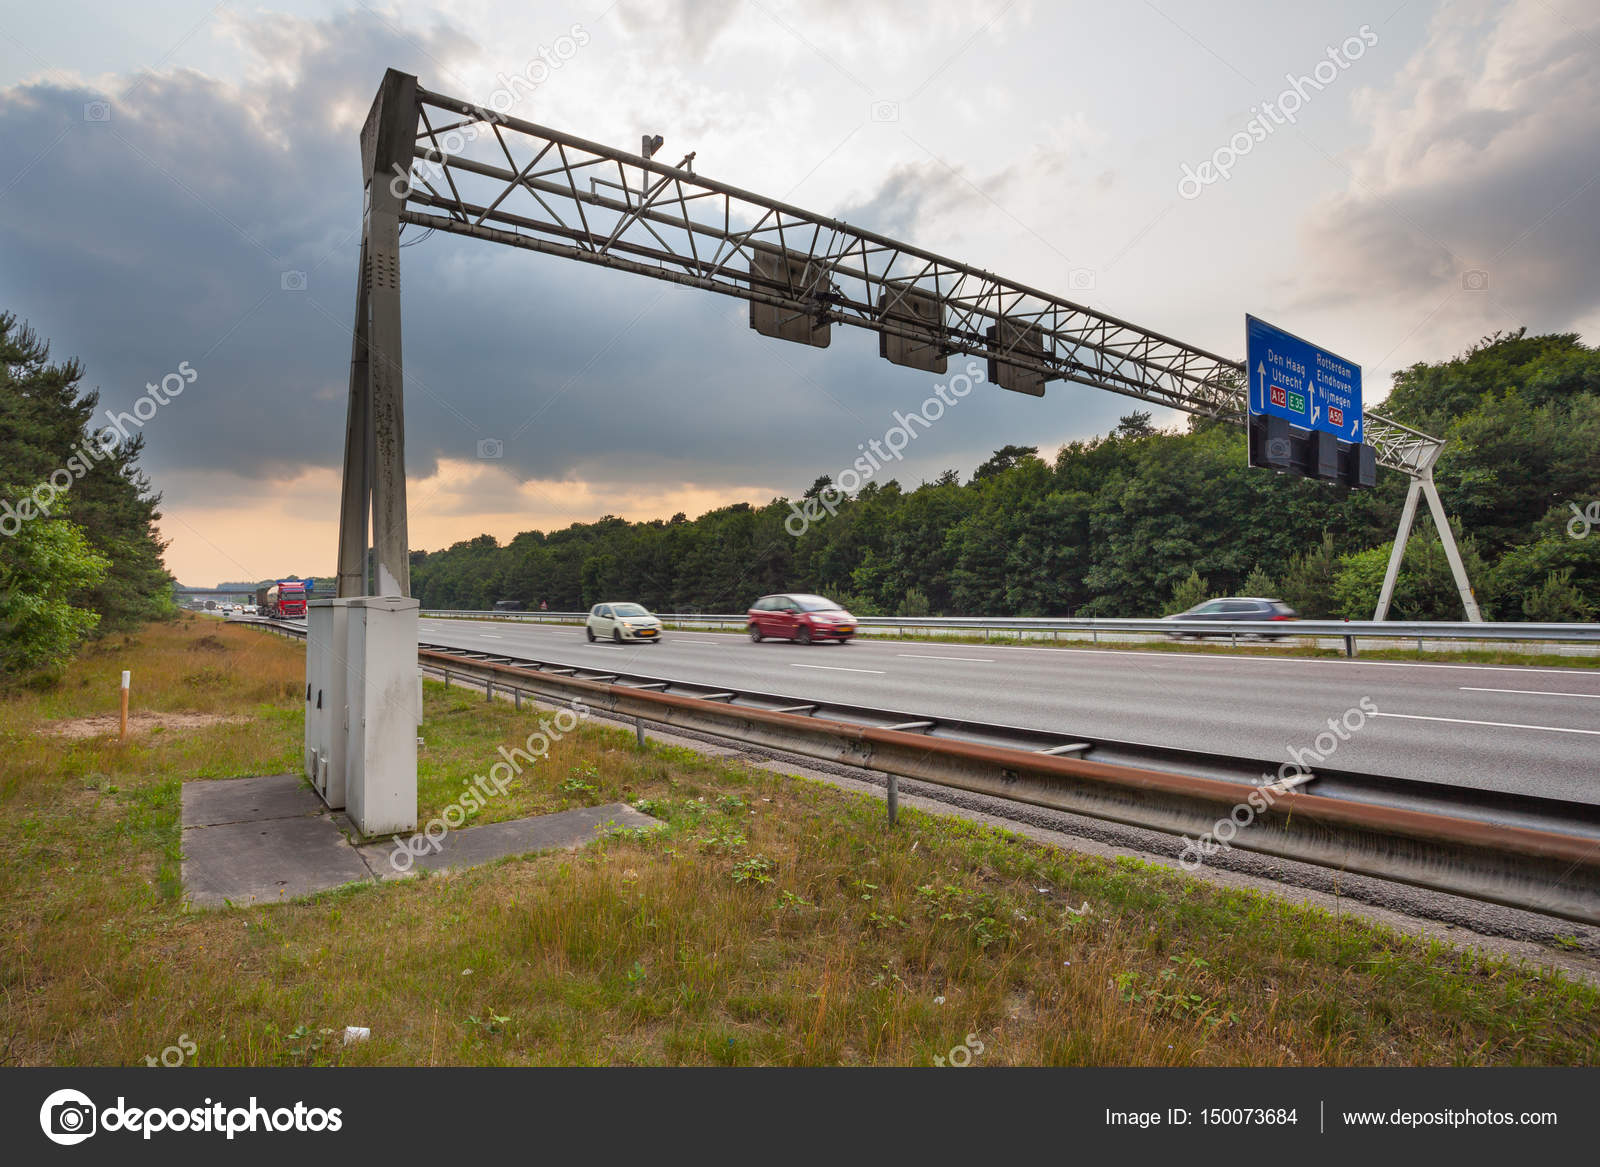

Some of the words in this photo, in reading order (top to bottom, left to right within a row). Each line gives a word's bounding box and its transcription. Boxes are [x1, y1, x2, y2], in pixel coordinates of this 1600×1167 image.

[1268, 349, 1284, 365] Den
[1286, 356, 1306, 378] Haag
[1316, 353, 1352, 378] Rotterdam
[1272, 368, 1303, 391] Utrecht
[1316, 369, 1352, 393] Eindhoven
[1271, 389, 1285, 404] A12
[1319, 386, 1351, 409] Nijmegen
[1329, 410, 1342, 423] A50
